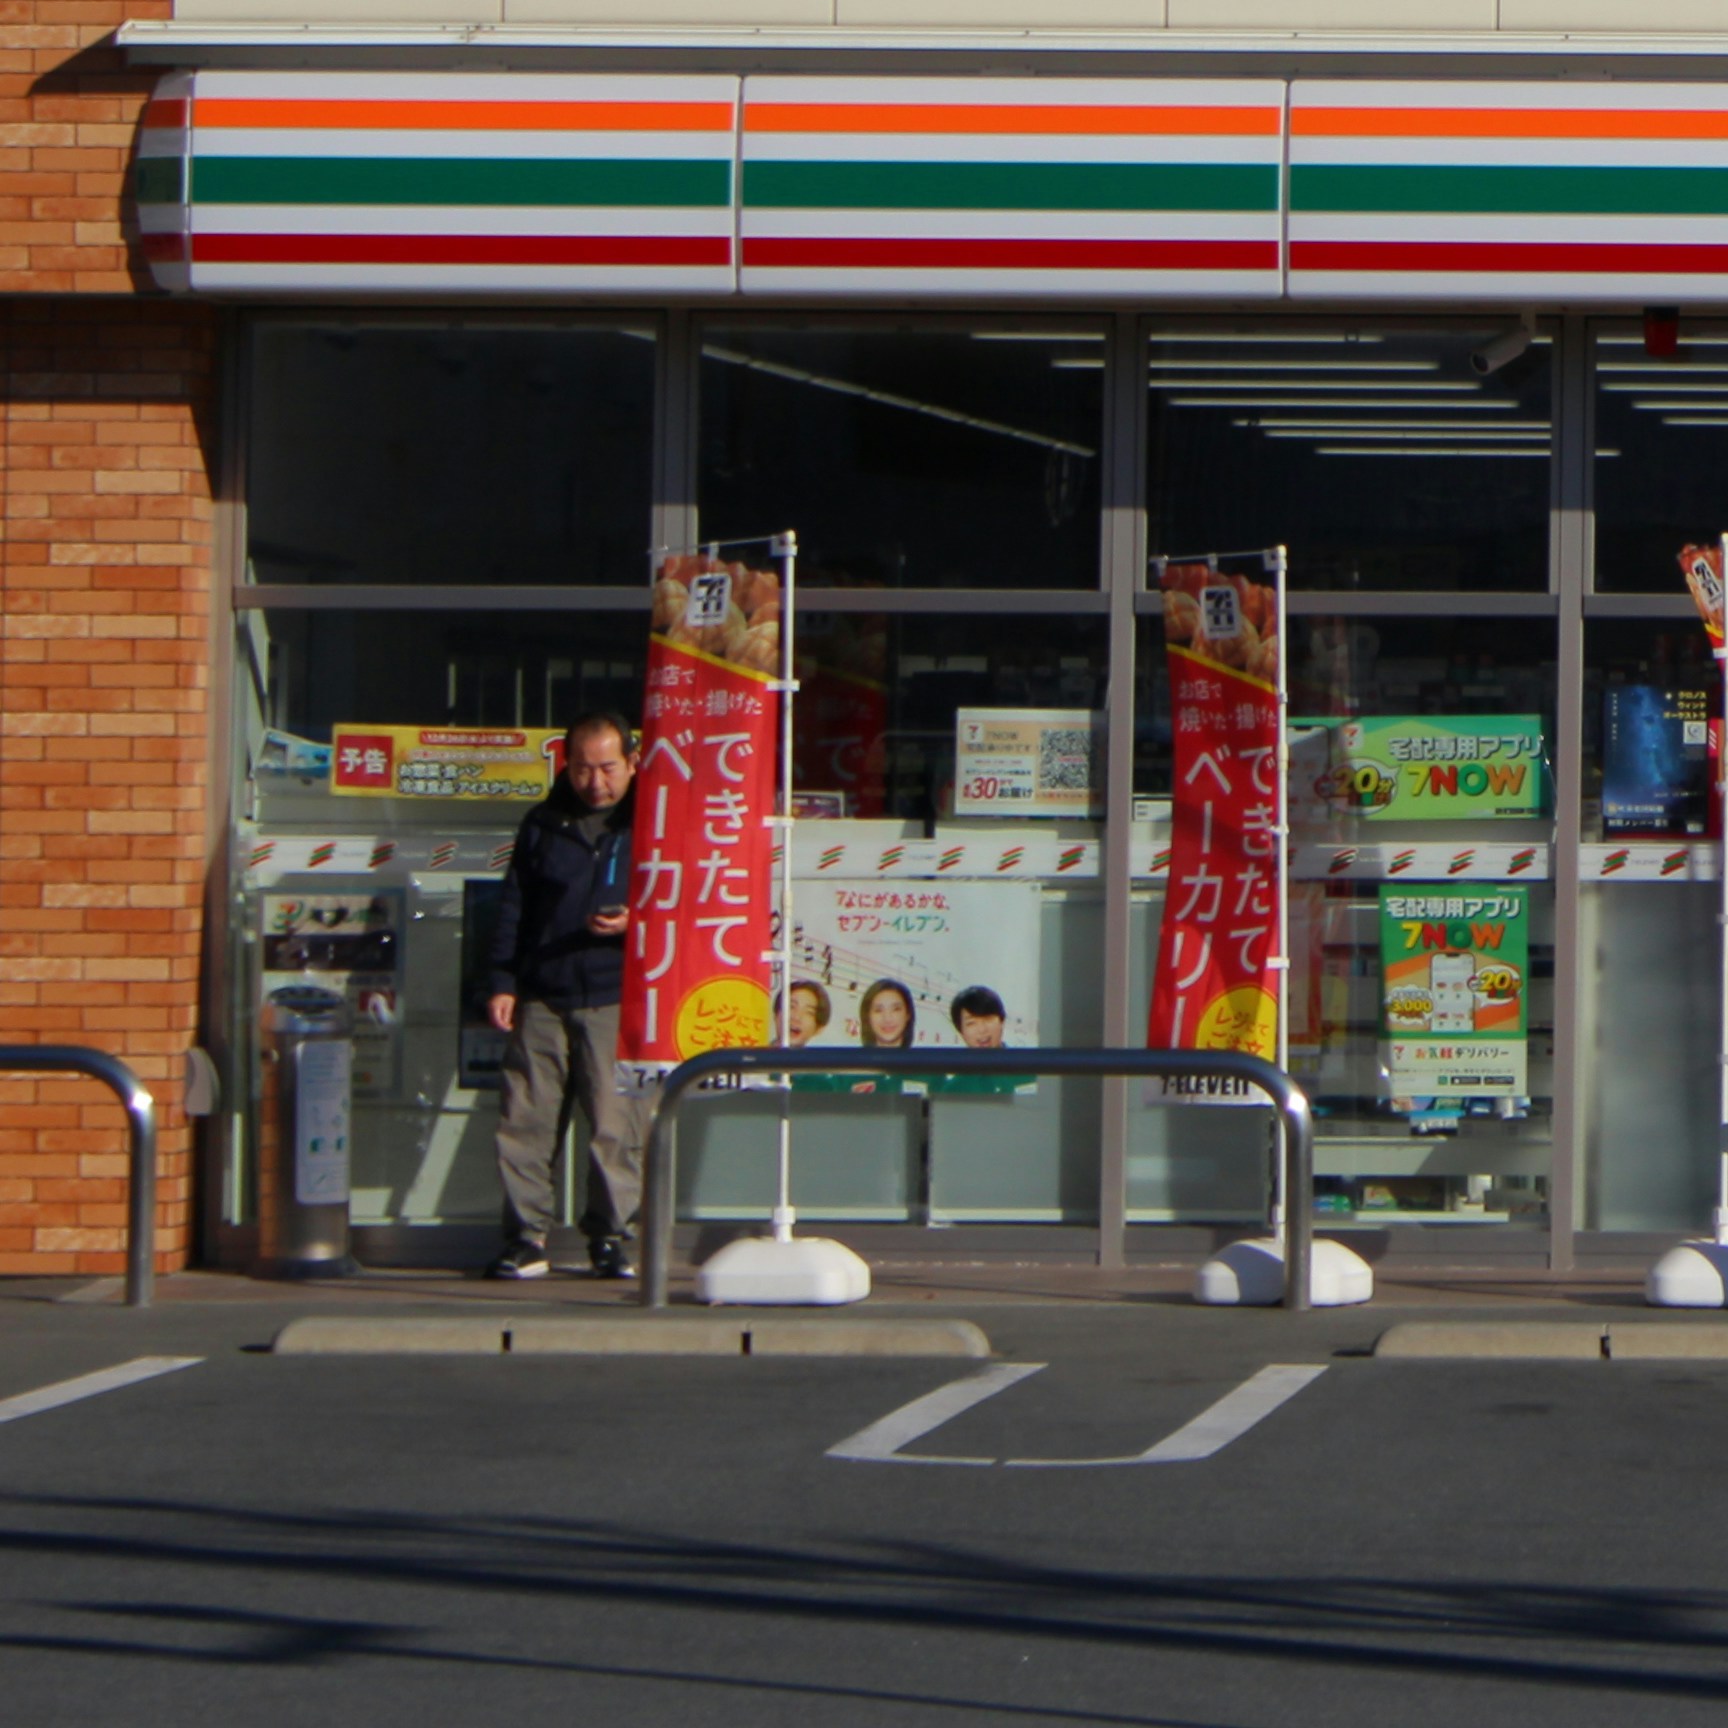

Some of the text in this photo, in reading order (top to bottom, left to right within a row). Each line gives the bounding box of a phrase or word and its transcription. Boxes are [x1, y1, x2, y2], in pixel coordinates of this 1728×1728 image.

[339, 747, 388, 775] 予告
[1388, 734, 1543, 762] 宅配専用アプリ
[1407, 763, 1526, 796] 7NOW
[695, 731, 754, 967] できたて
[1228, 744, 1277, 974] できたて
[636, 729, 695, 1044] ベーカリー
[1169, 737, 1231, 1049] ベーカリー
[1386, 896, 1521, 918] 宅配専用アプリ
[1402, 922, 1505, 950] 7NOW
